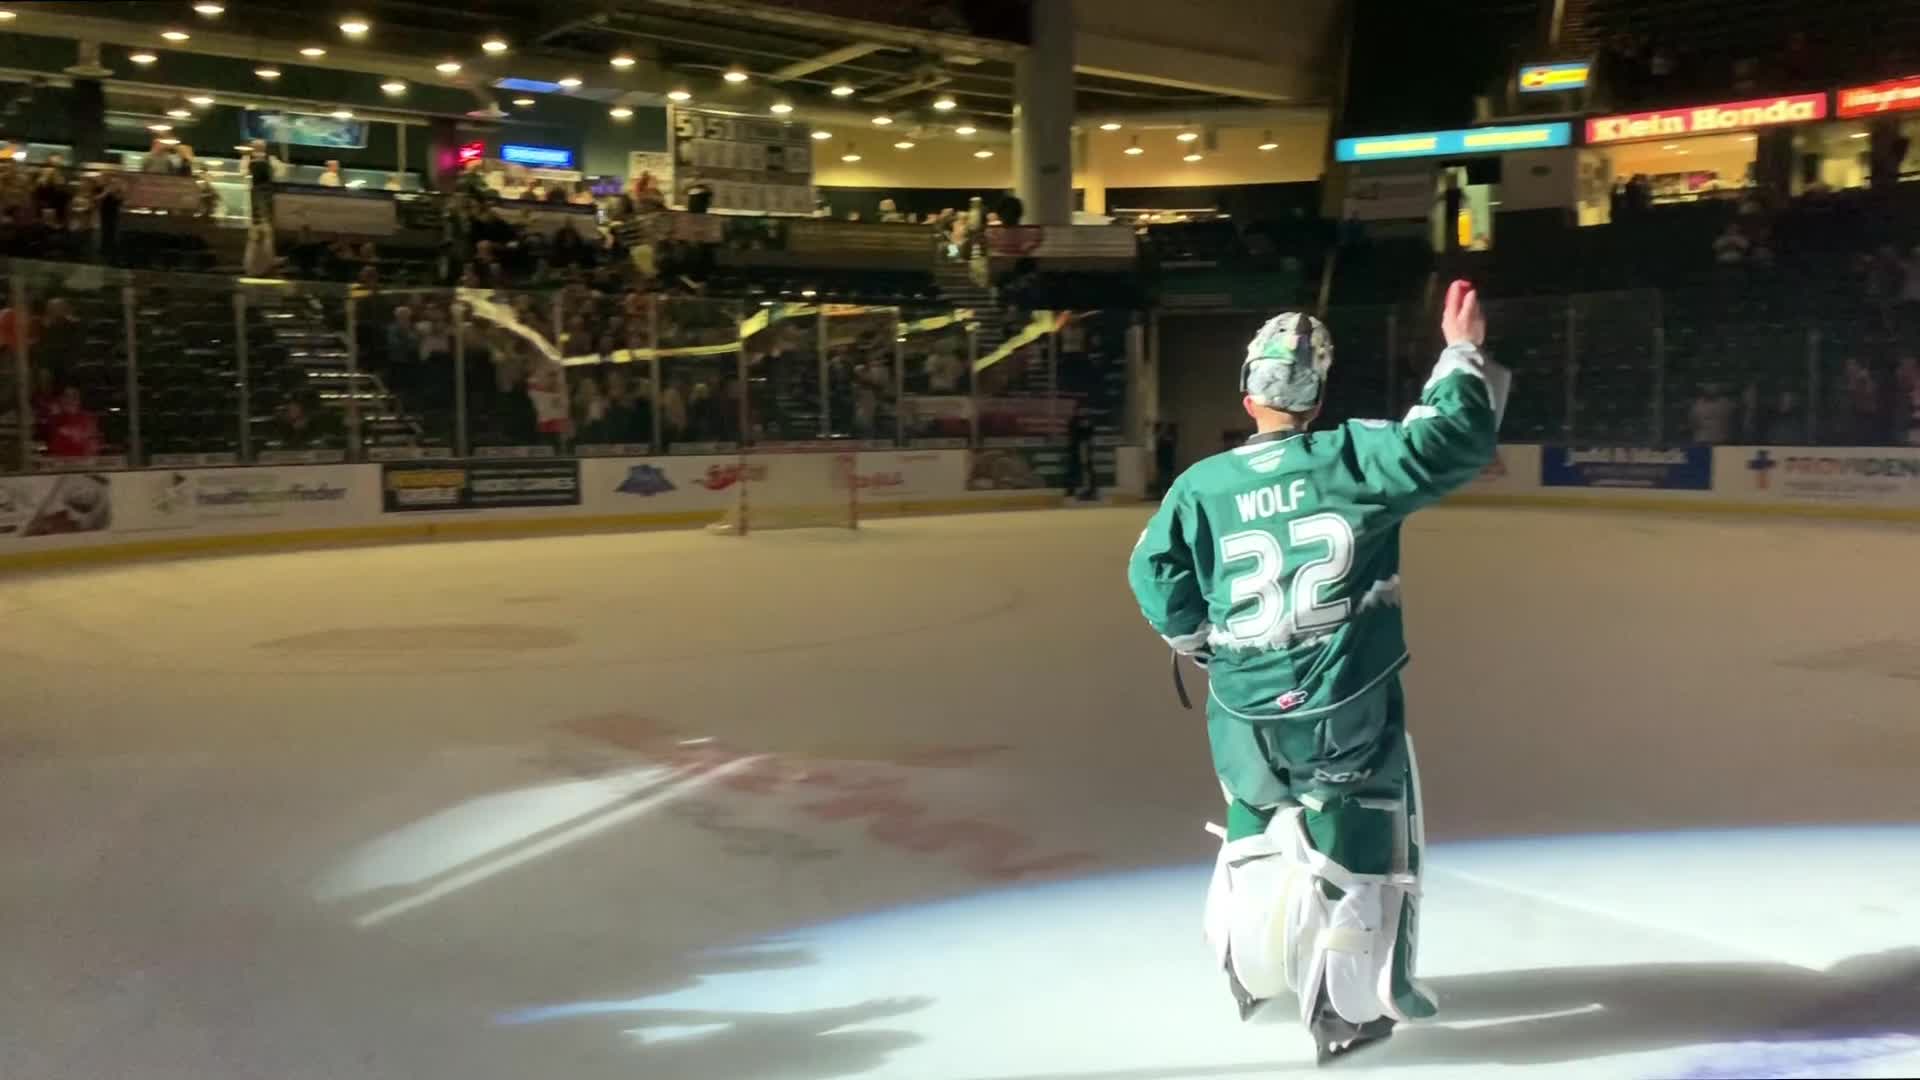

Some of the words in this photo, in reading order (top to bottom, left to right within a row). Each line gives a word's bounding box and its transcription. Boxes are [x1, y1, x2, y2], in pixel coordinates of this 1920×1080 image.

[1593, 116, 1685, 141] Klein
[1692, 101, 1815, 131] Honda
[1235, 478, 1306, 522] WOLF
[1219, 512, 1354, 640] 32
